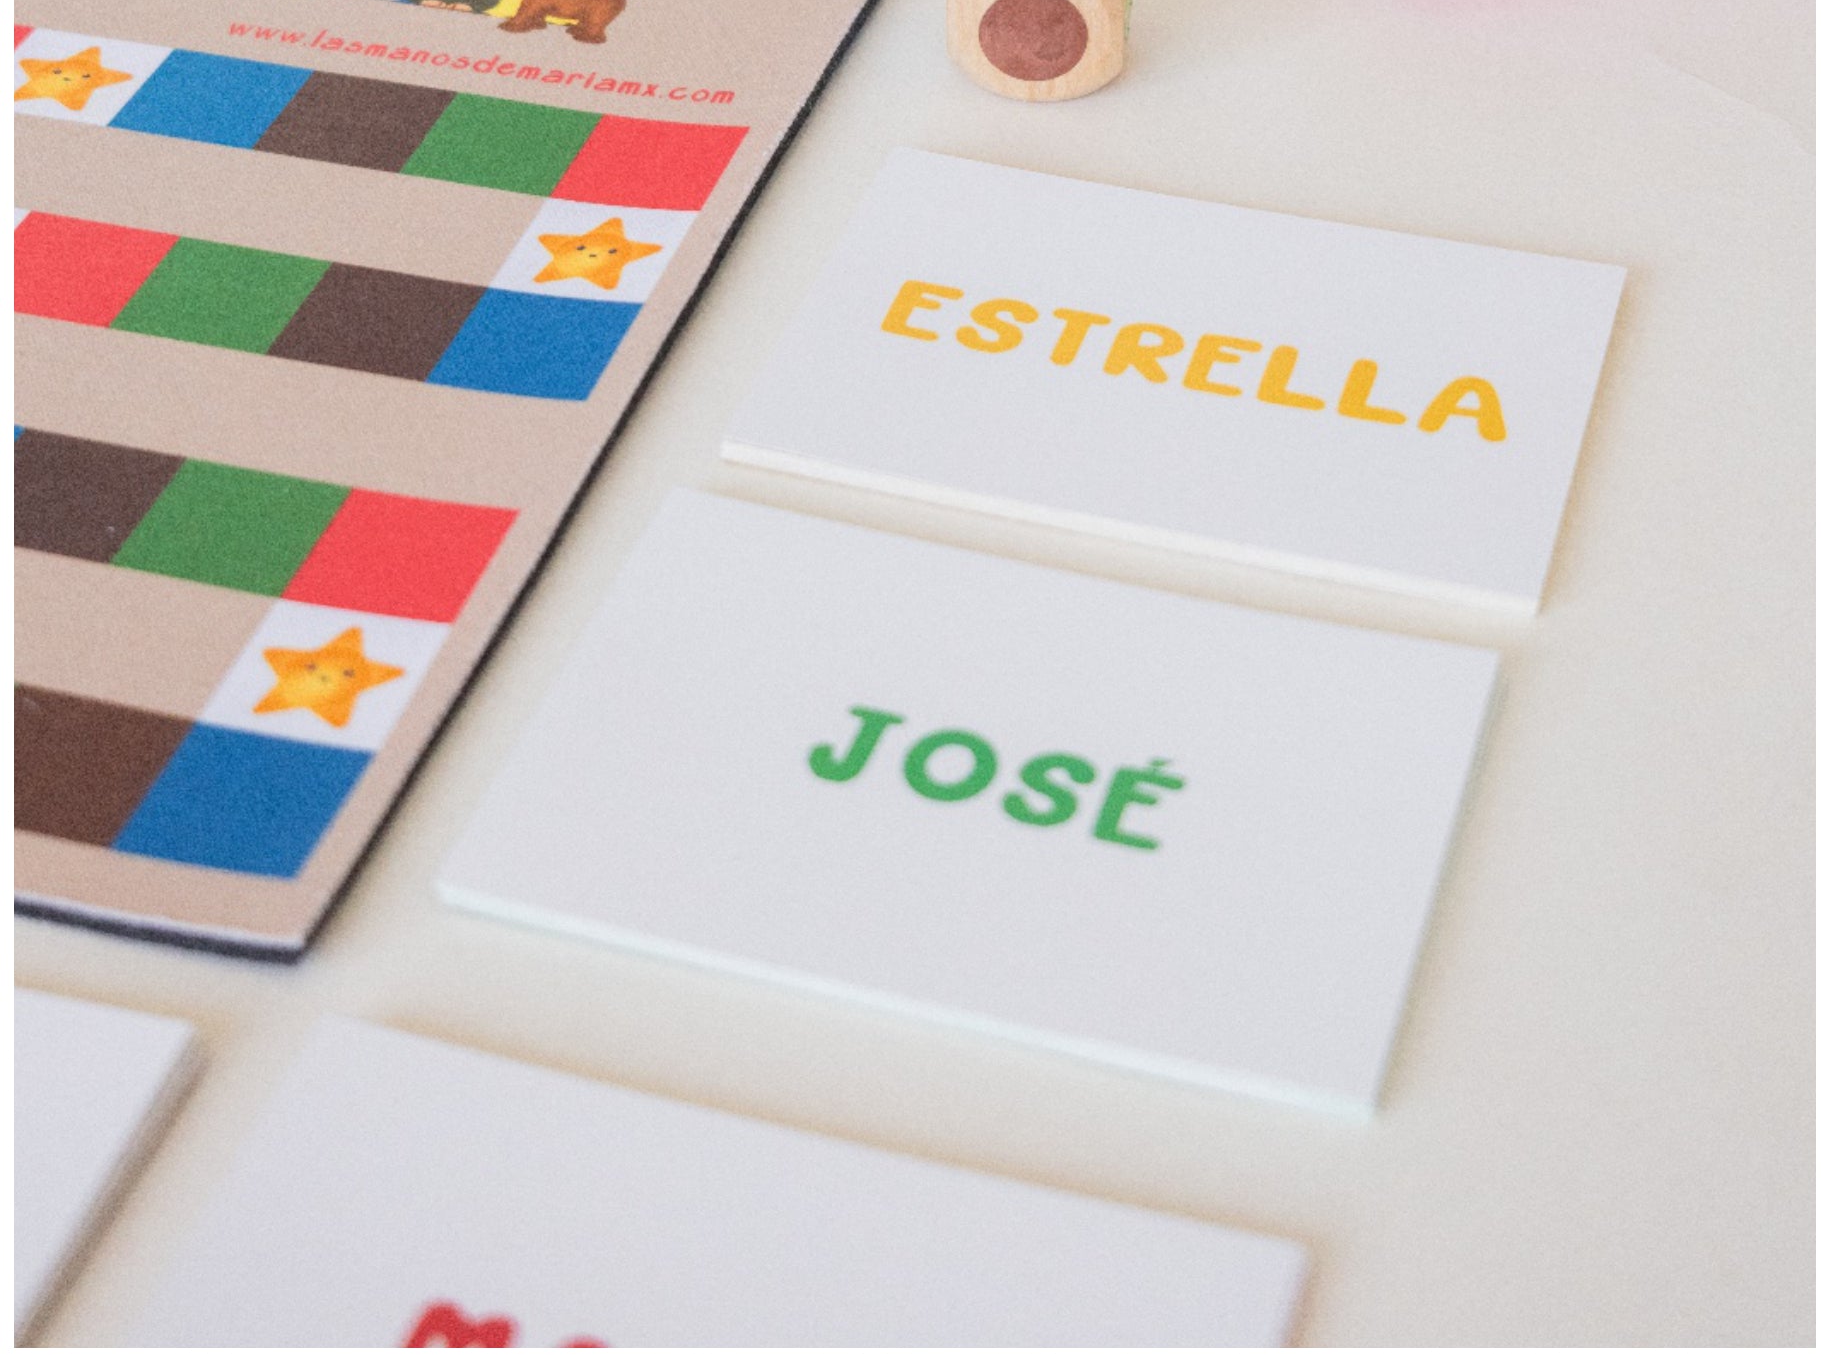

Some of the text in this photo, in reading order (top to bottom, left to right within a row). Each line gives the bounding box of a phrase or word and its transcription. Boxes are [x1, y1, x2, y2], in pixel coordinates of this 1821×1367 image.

[228, 22, 736, 104] www.lasmanosdemariamx.com
[880, 279, 1508, 443] ESTRELLA
[808, 706, 1184, 850] JOSÉ
